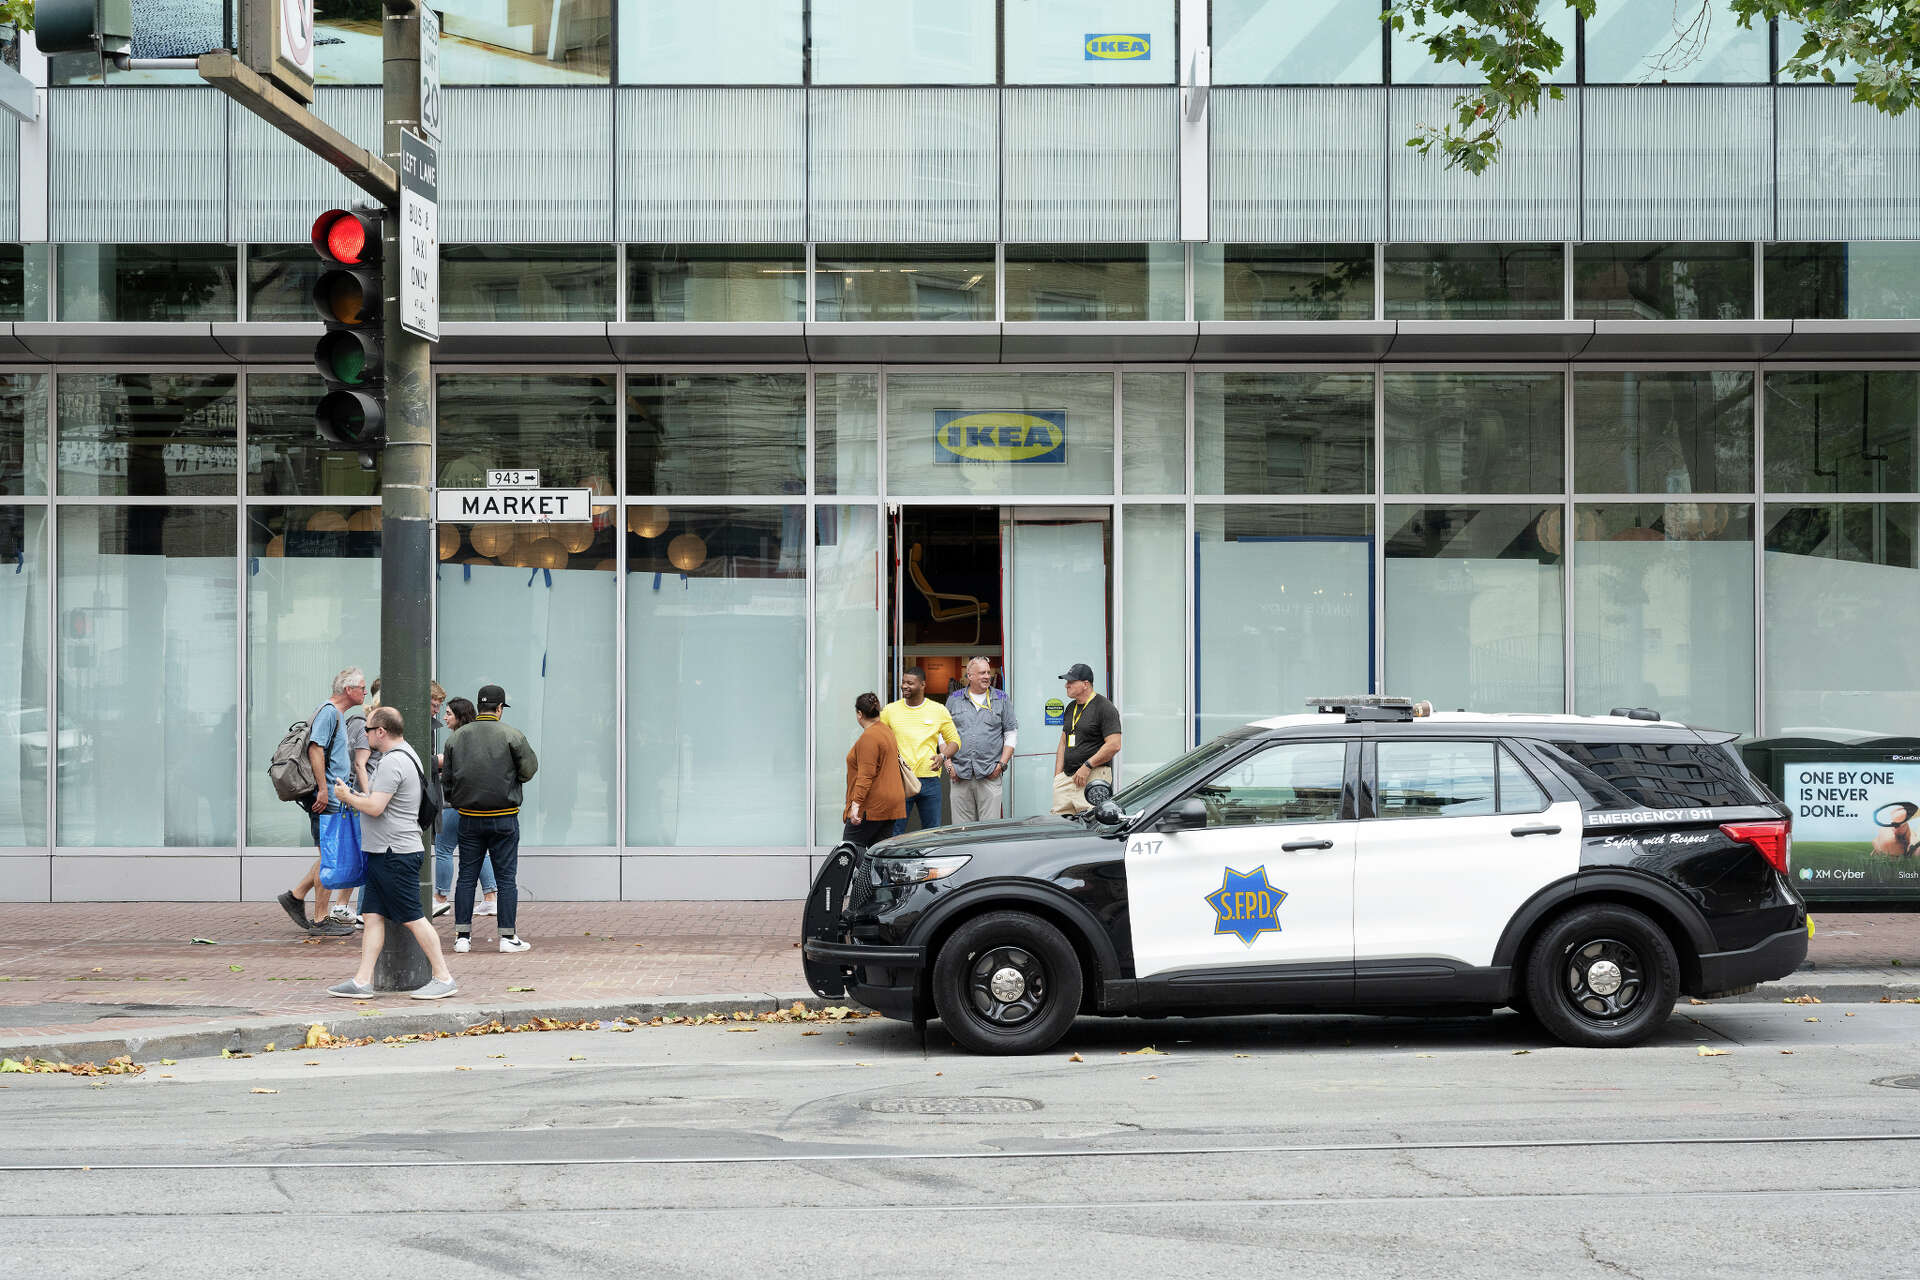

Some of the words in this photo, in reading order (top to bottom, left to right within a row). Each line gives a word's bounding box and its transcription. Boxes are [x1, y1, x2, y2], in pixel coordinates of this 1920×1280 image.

[1092, 41, 1145, 52] IKEA
[423, 76, 439, 128] 20
[402, 149, 417, 177] LEFT
[419, 159, 436, 188] LANE
[409, 203, 422, 226] BUS
[412, 236, 428, 261] TAXI
[410, 266, 428, 291] ONLY
[947, 426, 1053, 447] IKEA
[495, 472, 519, 485] 943
[462, 496, 569, 515] MARKET
[1800, 772, 1834, 785] ONE
[1838, 772, 1857, 785] BY
[1860, 772, 1895, 785] ONE
[1800, 788, 1813, 801] IS
[1817, 788, 1869, 801] NEVER
[1588, 811, 1684, 825] EMERGENCY
[1690, 809, 1713, 820] 911
[1800, 805, 1858, 818] DONE...
[1131, 841, 1163, 855] 417
[1603, 836, 1639, 849] Safety
[1642, 834, 1666, 845] with
[1669, 833, 1710, 845] Respect
[1815, 869, 1831, 879] XM
[1833, 868, 1866, 880] Cyber
[1898, 871, 1919, 879] Slash
[1220, 890, 1274, 921] S.F.P.D.
